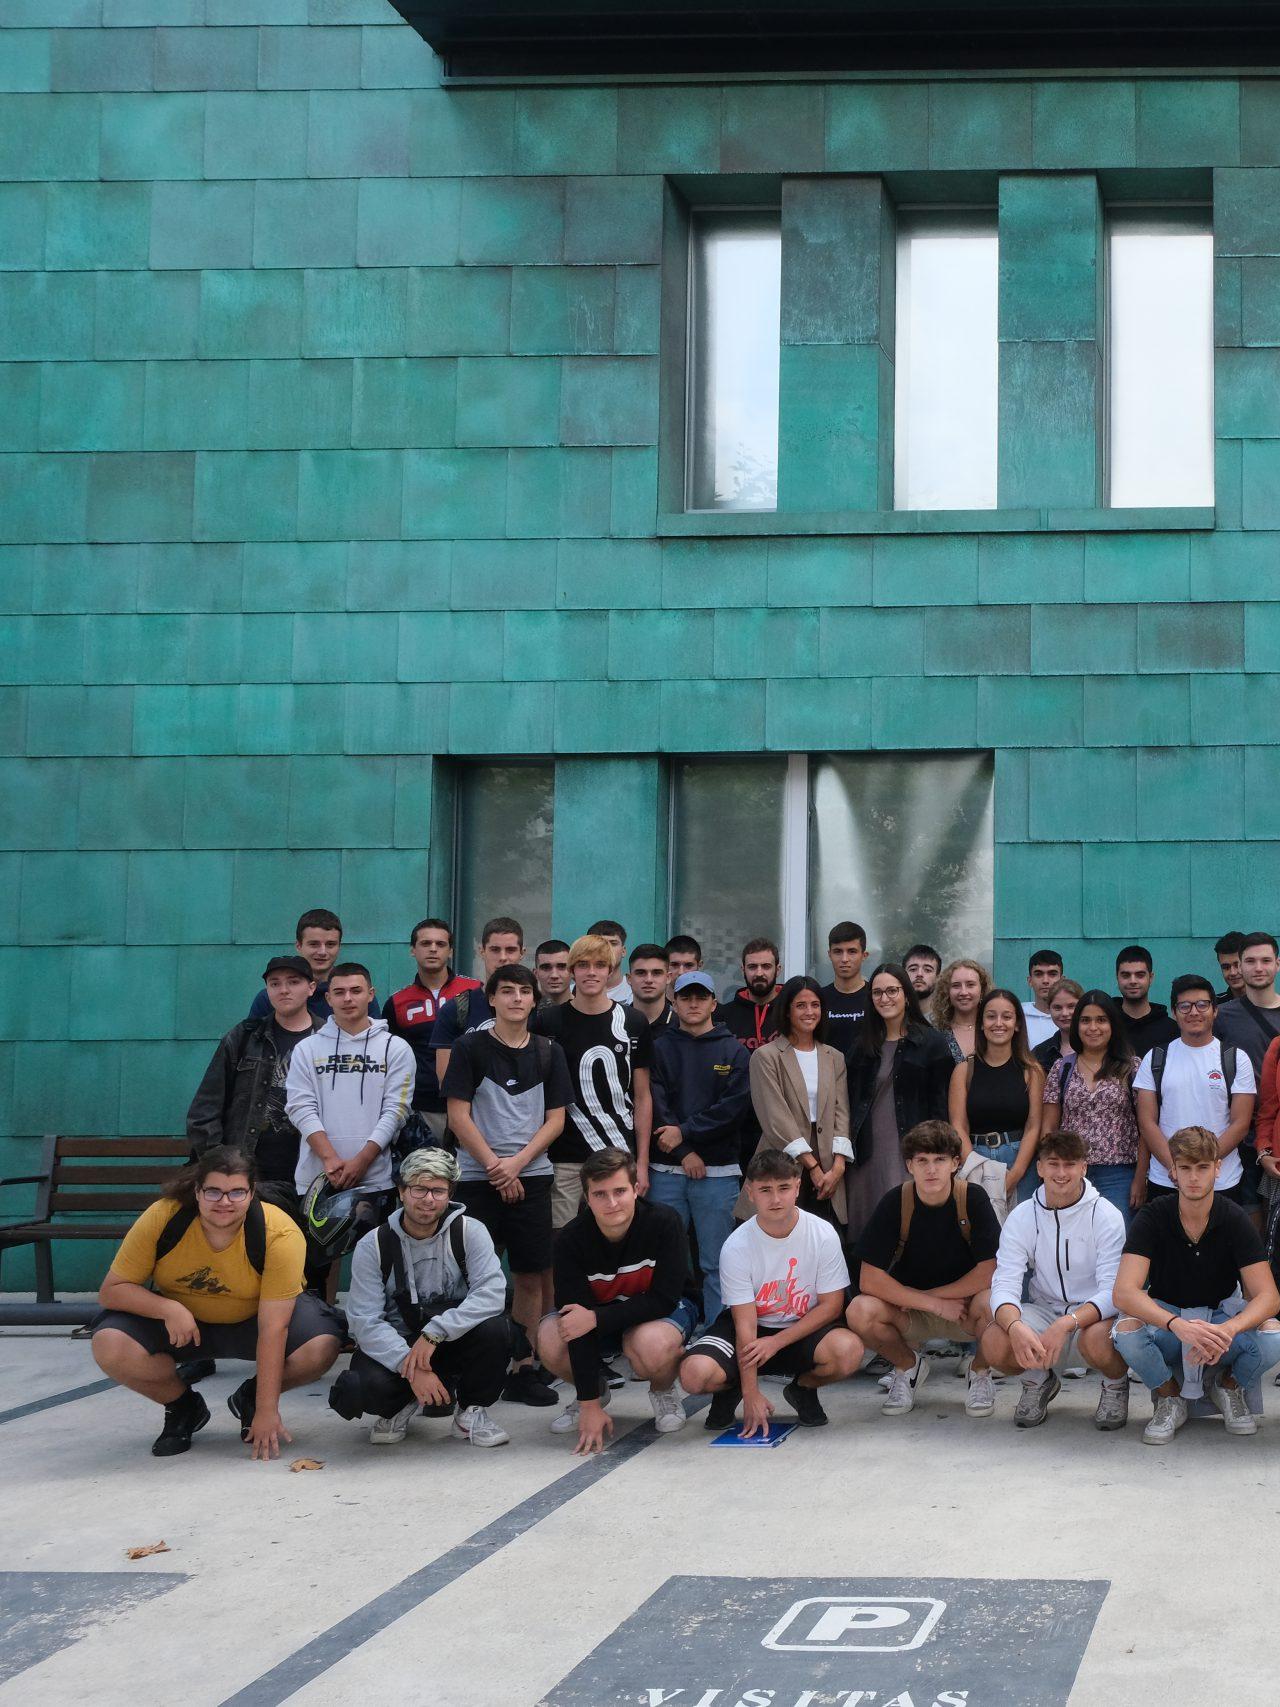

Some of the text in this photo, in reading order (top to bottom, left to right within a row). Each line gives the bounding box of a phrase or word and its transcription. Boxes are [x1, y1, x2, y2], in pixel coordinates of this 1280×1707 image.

[406, 997, 447, 1021] FI
[828, 1010, 865, 1021] hampi
[328, 1054, 377, 1064] REAL
[315, 1063, 387, 1075] DREAMS
[805, 1606, 910, 1641] P
